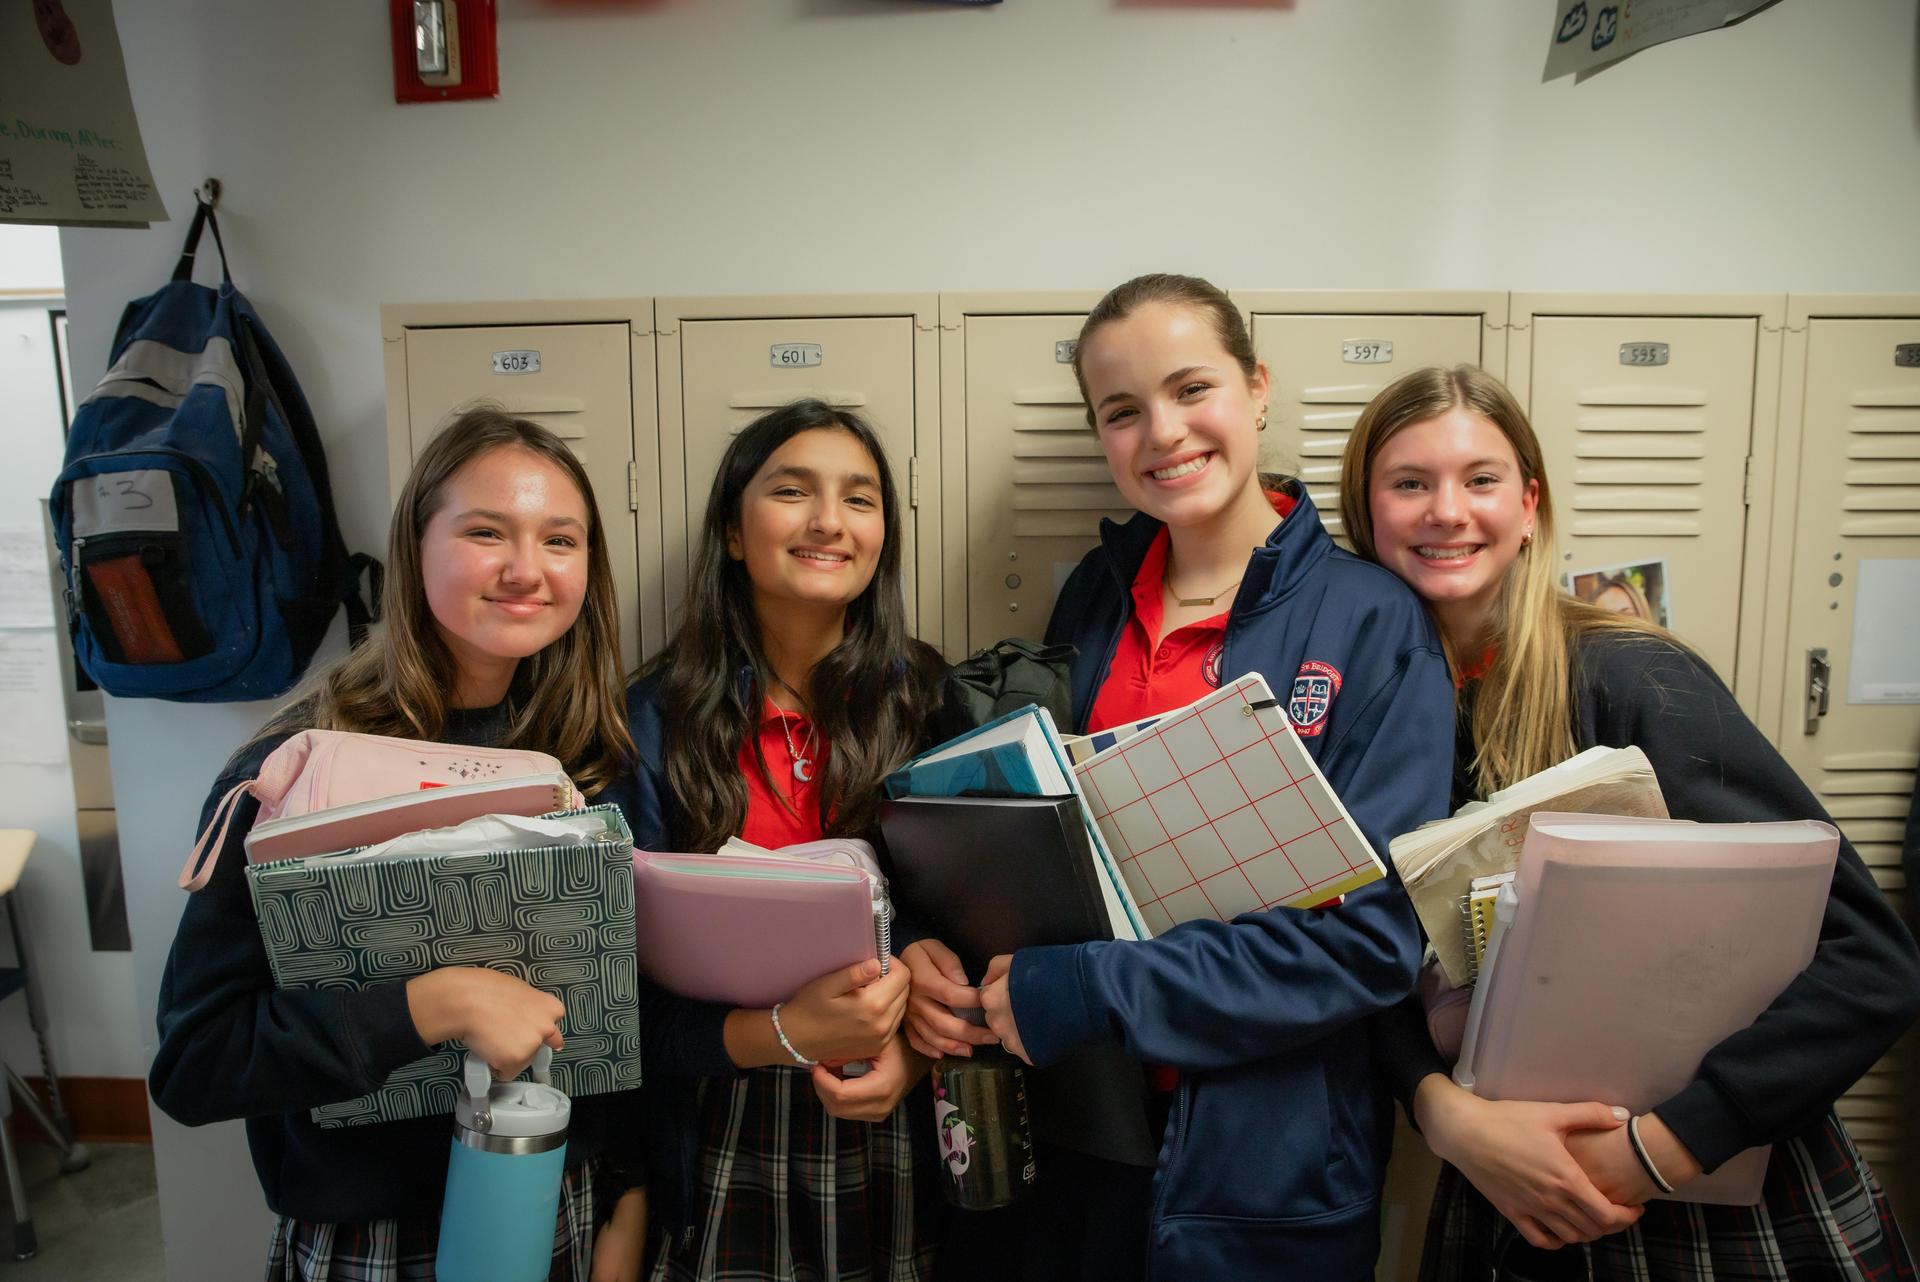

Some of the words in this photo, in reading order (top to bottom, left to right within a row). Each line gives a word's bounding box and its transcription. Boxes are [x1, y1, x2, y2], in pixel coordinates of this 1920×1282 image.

[781, 349, 806, 364] 601
[1353, 345, 1379, 360] 597
[1631, 348, 1656, 362] 595
[502, 356, 528, 370] 603
